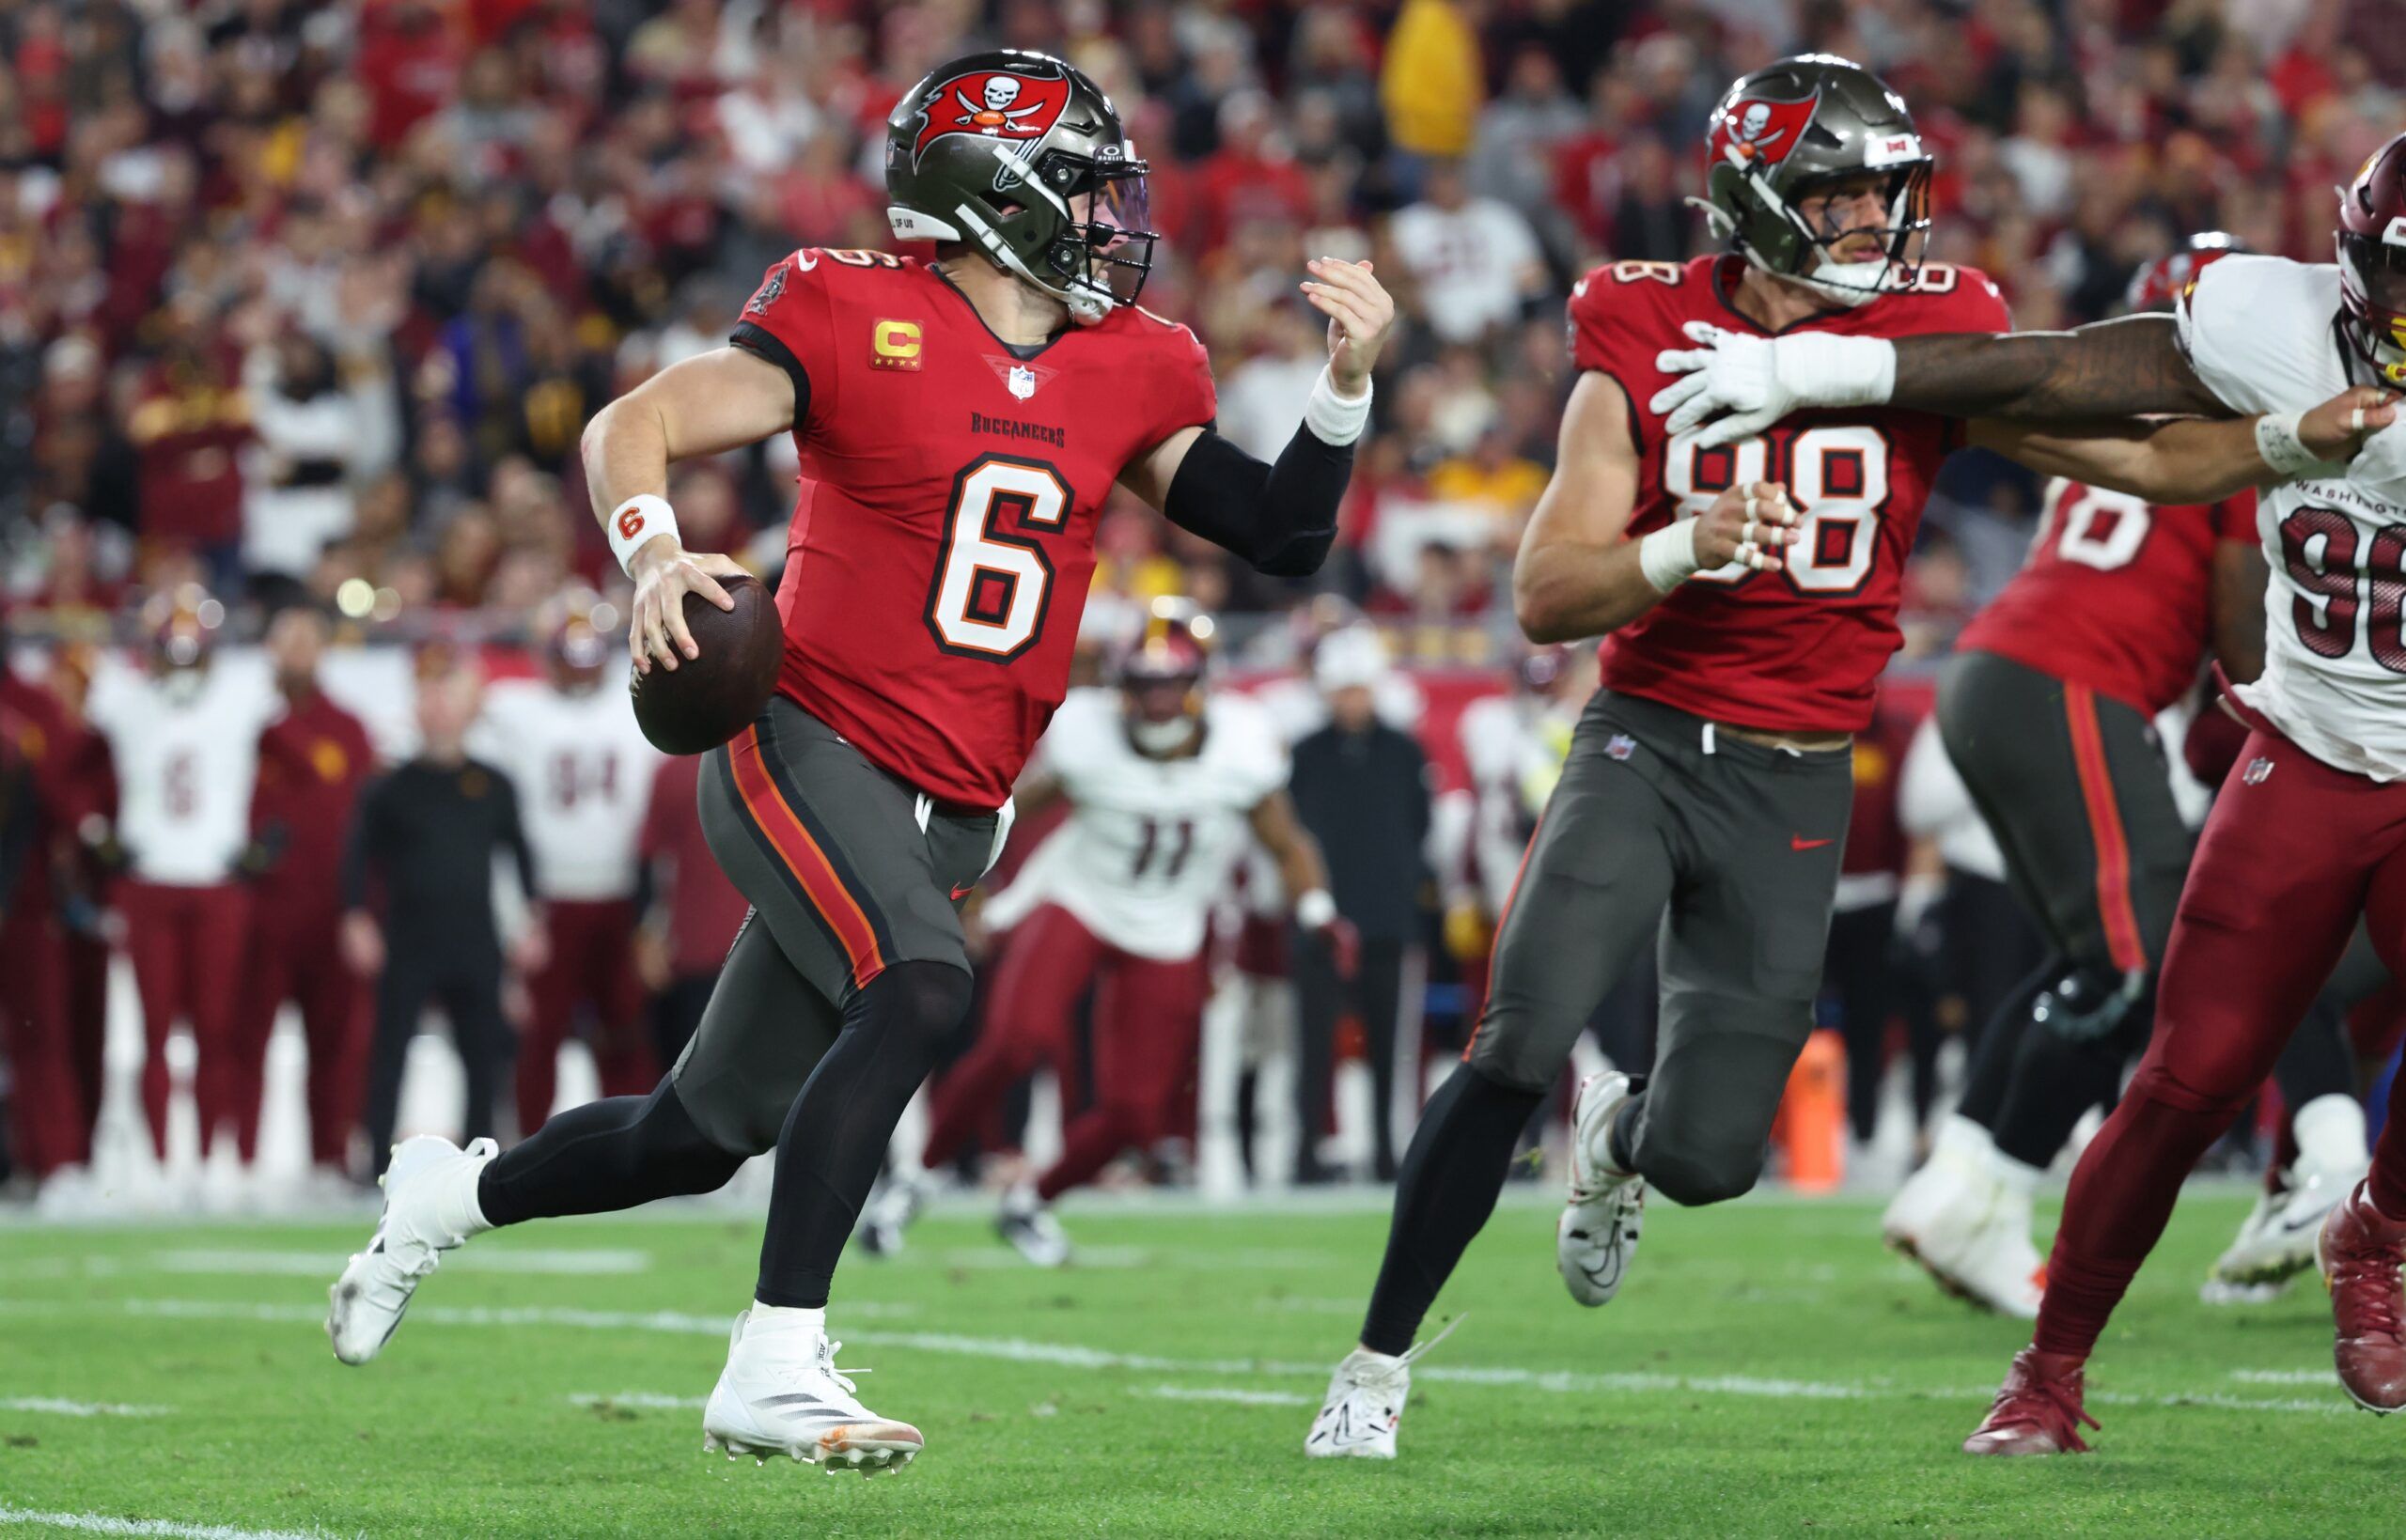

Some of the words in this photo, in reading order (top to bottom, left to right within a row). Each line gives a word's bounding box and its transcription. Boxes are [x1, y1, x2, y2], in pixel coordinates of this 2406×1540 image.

[904, 218, 914, 228] US
[874, 320, 920, 357] C
[1662, 423, 1893, 598] 88
[2295, 478, 2406, 517] WASHIGT
[617, 506, 645, 540] 6
[922, 451, 1075, 666] 6
